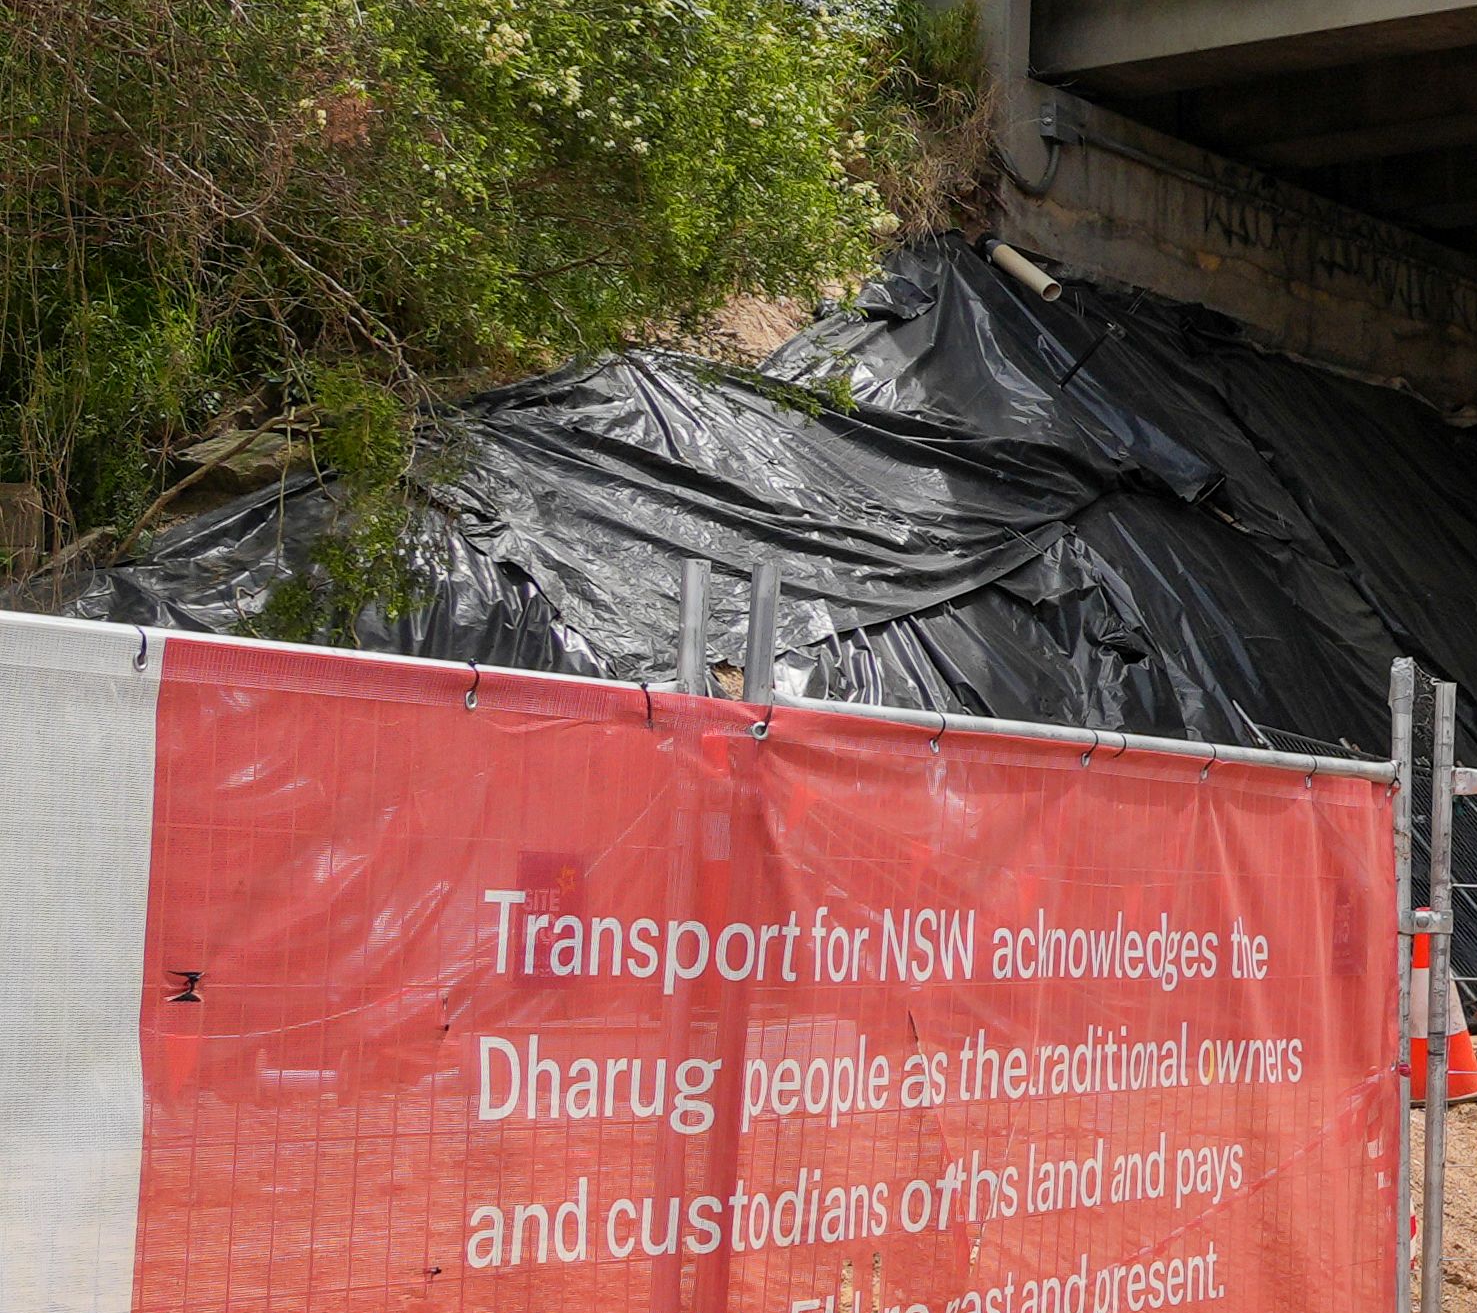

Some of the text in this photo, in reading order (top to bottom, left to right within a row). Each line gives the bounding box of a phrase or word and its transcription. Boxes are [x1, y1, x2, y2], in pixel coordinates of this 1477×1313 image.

[485, 889, 800, 995] Transport
[812, 906, 870, 983] for
[880, 908, 975, 983] NSW
[1230, 916, 1268, 981] the
[478, 1034, 722, 1135] Dharug
[742, 1034, 890, 1133] people
[901, 1050, 948, 1108] as
[960, 1028, 1027, 1101] the
[1198, 1038, 1303, 1085] owners
[466, 1176, 588, 1269] and
[606, 1167, 889, 1258] custodians
[1026, 1137, 1104, 1213] land
[1110, 1131, 1166, 1203] and
[1176, 1143, 1244, 1209] pays
